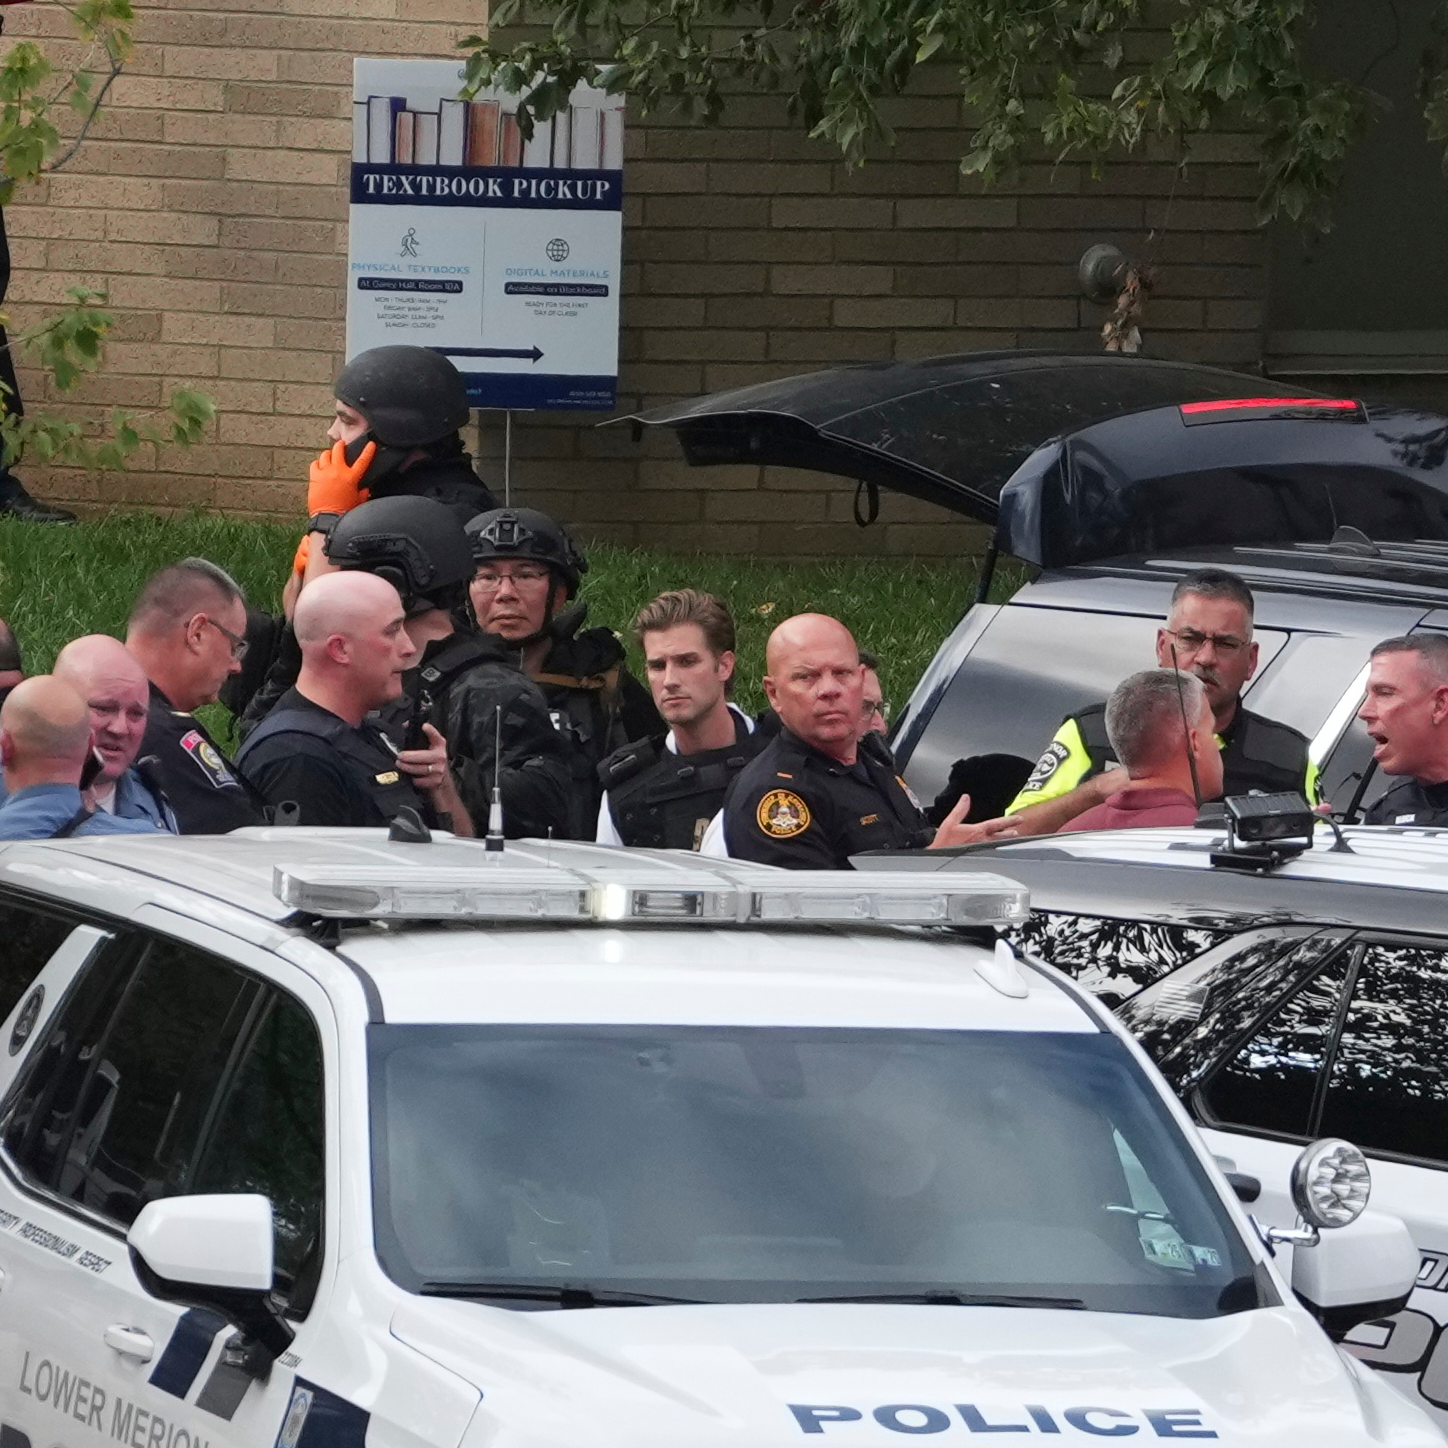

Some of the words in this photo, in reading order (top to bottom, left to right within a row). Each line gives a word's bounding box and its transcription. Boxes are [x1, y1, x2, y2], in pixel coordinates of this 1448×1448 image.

[363, 173, 504, 197] TEXTBOOK
[512, 178, 611, 200] PICKUP
[351, 262, 403, 273] PHYSICAL
[407, 264, 470, 275] TEXTBOOKS
[505, 268, 547, 277] DIGITAL
[550, 269, 610, 279] MATERIALS
[19, 1350, 106, 1432] LOWER
[786, 1403, 1220, 1440] POLICE
